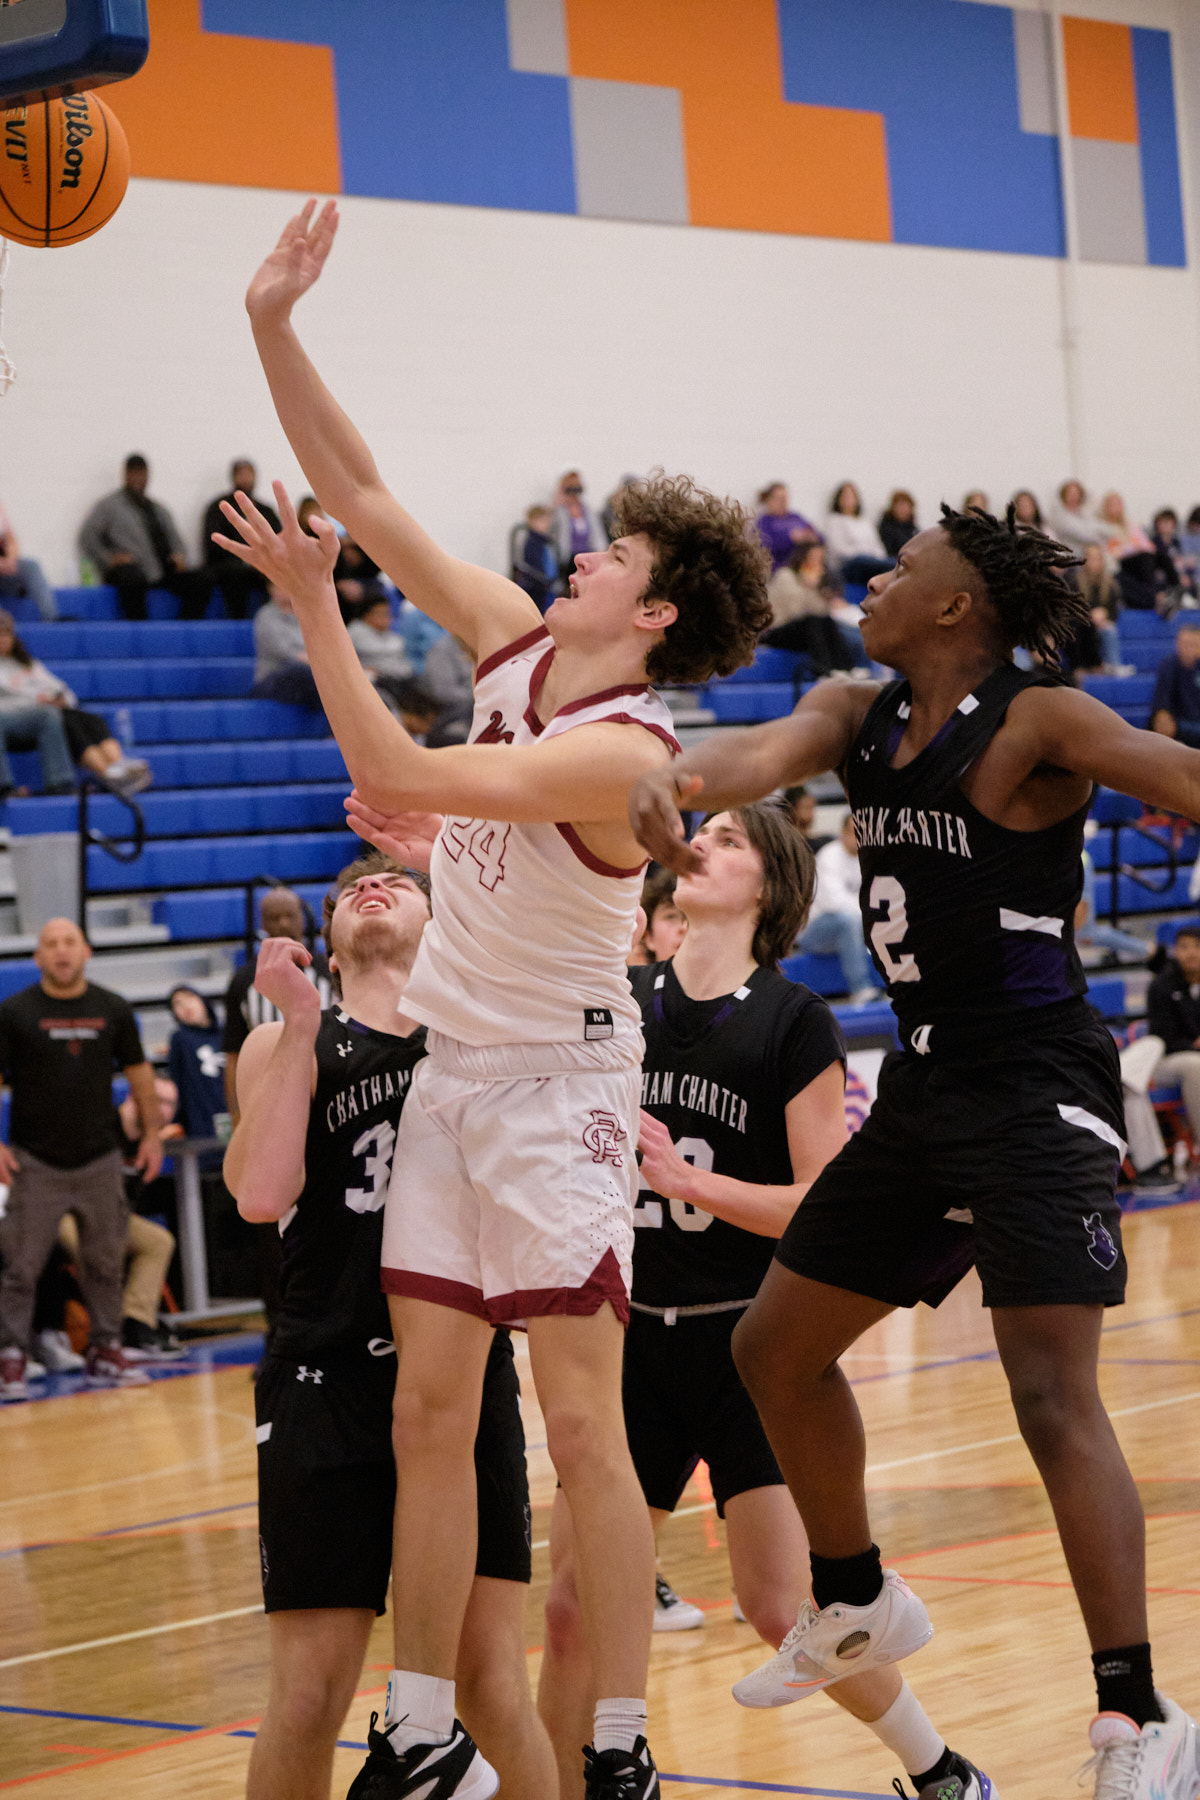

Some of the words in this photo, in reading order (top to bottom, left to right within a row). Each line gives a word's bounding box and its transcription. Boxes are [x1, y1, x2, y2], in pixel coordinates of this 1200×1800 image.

[869, 876, 921, 984] 2
[592, 1011, 605, 1023] M
[678, 1073, 748, 1135] CHARTER
